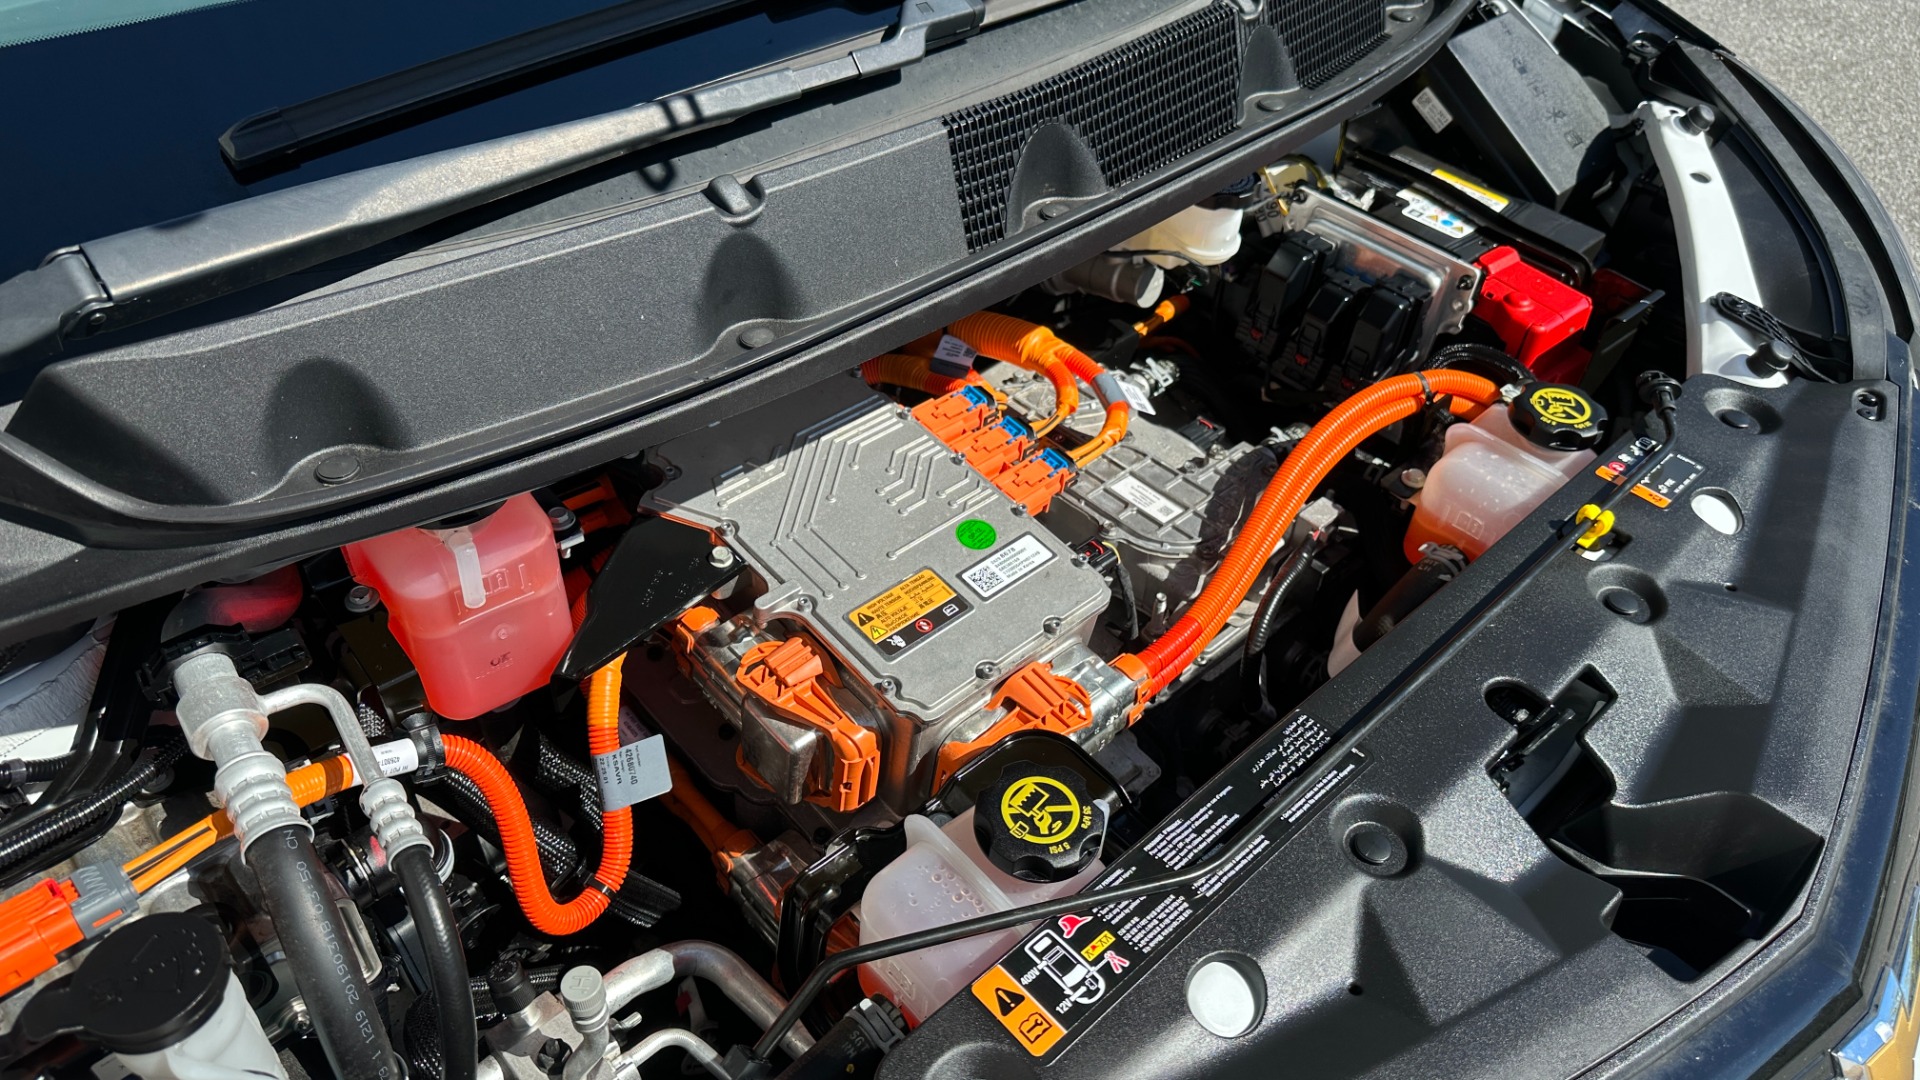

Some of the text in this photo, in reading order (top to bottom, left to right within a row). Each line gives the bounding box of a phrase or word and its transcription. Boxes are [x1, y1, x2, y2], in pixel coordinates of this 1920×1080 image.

[281, 826, 300, 851] CN
[1063, 842, 1071, 850] 5
[294, 858, 325, 916] 03:50
[318, 918, 361, 1006] 20190318
[1018, 966, 1041, 987] 400V
[1054, 997, 1073, 1015] 12V
[353, 1008, 376, 1045] 1219
